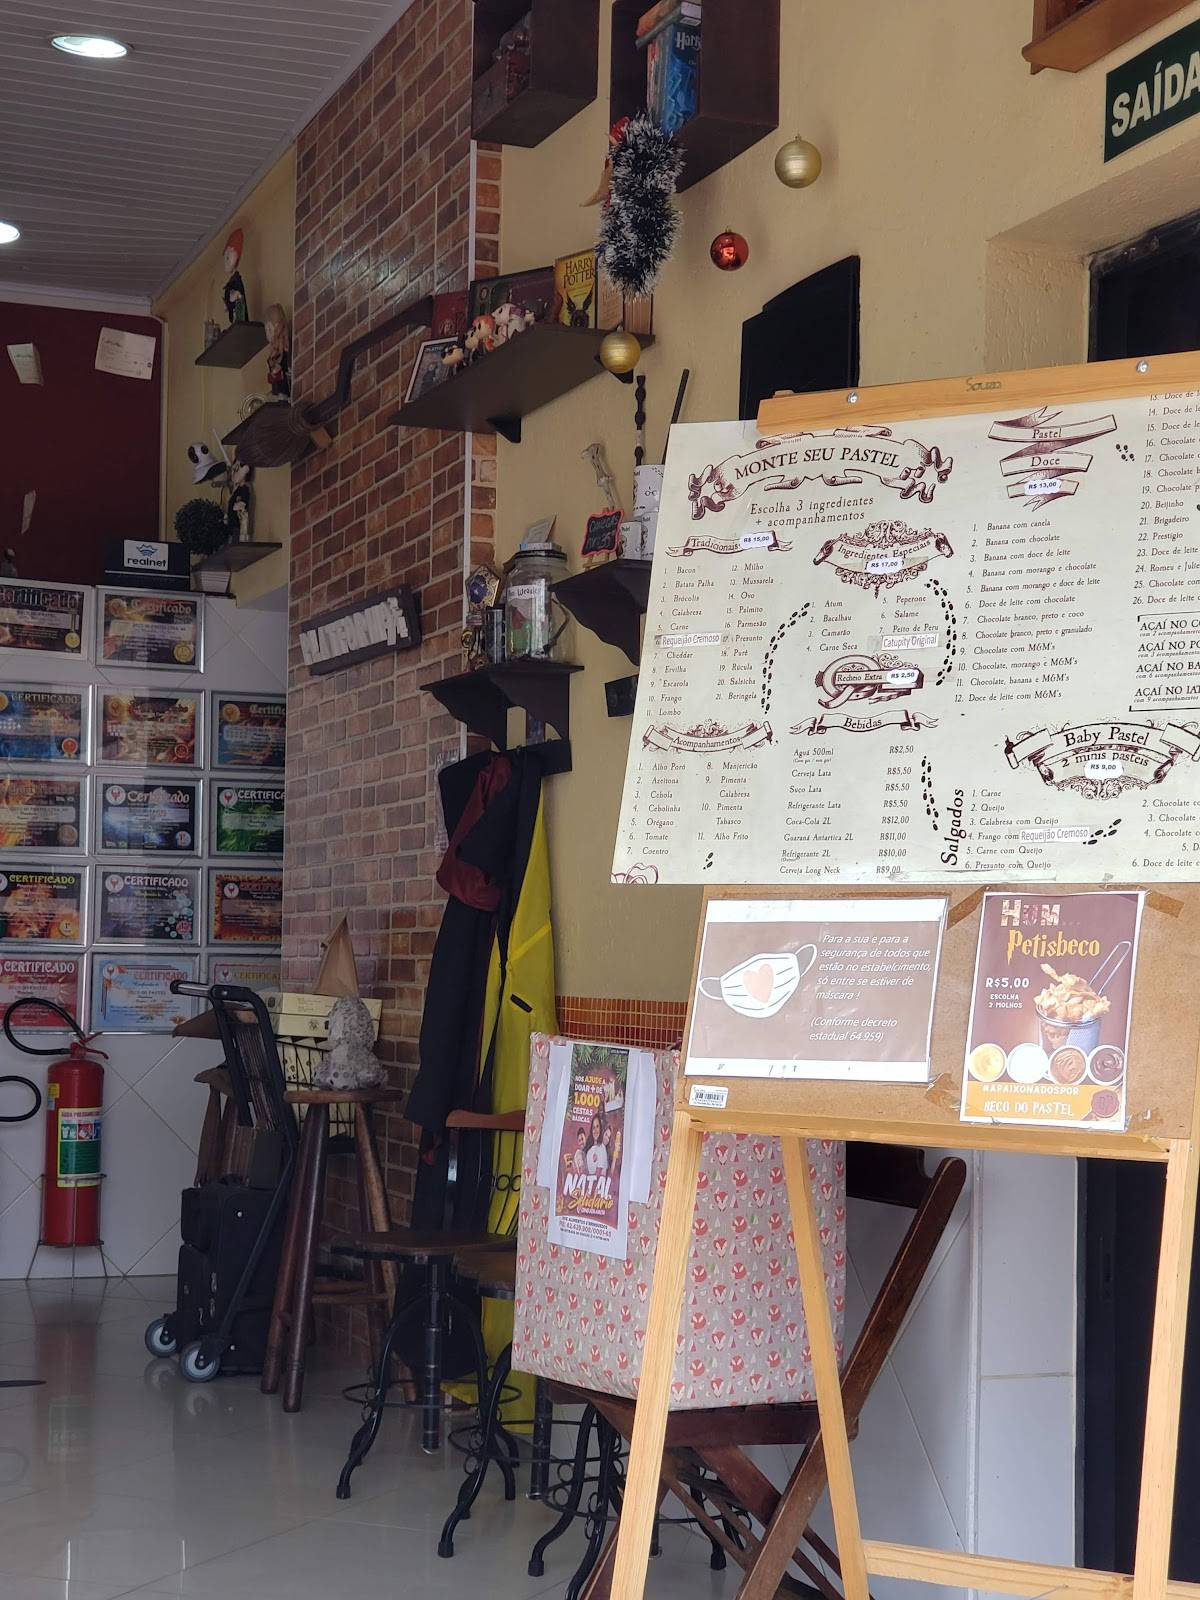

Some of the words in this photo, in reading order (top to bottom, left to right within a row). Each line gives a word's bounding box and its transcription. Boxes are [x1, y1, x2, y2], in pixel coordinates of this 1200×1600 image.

[676, 32, 700, 51] Harry
[1112, 51, 1200, 137] SAÍDA
[566, 257, 594, 275] HARRY
[564, 269, 595, 288] POTTER
[1032, 428, 1061, 439] Pastel
[735, 451, 798, 480] MONTE
[803, 448, 835, 462] SEU
[840, 448, 900, 468] PASTEL
[1031, 456, 1060, 467] Doce
[750, 503, 790, 515] Escolha
[797, 501, 803, 511] 3
[809, 497, 873, 513] ingredientes
[1156, 500, 1184, 509] Beijinho
[767, 512, 864, 528] acompanhamentos
[1154, 516, 1189, 526] Brigadeiro
[987, 523, 1010, 531] Banana
[1029, 535, 1060, 543] chocolate
[839, 545, 888, 560] Ingredientes
[893, 540, 931, 559] Especiais
[128, 558, 166, 567] realnet
[1044, 596, 1075, 604] chocolate
[978, 615, 1010, 623] Chocolate
[1042, 613, 1058, 621] preto
[1140, 619, 1167, 632] AÇAÍ
[1170, 621, 1187, 629] NO
[663, 637, 691, 647] Requeijão
[693, 635, 719, 643] Cremoso
[11, 693, 78, 704] CERTIFICADO
[844, 718, 882, 729] Bebidas
[1064, 730, 1100, 746] Baby
[1108, 726, 1149, 745] Pastel
[674, 736, 741, 748] Acompanhamentos
[813, 748, 833, 756] 500ml
[890, 745, 913, 753] R$2,50
[1062, 759, 1070, 767] 2
[1076, 752, 1106, 764] minis
[1113, 751, 1149, 766] pasteis
[792, 770, 815, 778] Cerveja
[887, 767, 911, 775] R$5,50
[981, 804, 1004, 812] Queijo
[882, 816, 909, 824] R$12,00
[1035, 817, 1058, 825] Queijo
[941, 789, 966, 865] Salgados
[978, 832, 1001, 842] Frango
[1022, 830, 1055, 841] Requeijão
[1057, 829, 1088, 838] Cremoso
[9, 875, 75, 884] CERTIFICADO
[124, 876, 188, 887] CERTIFICADO
[823, 935, 844, 943] Para
[879, 936, 900, 945] para
[1007, 930, 1100, 965] Petisbeco
[821, 950, 867, 960] segurança
[870, 949, 882, 957] de
[884, 949, 910, 957] todos
[913, 951, 929, 959] que
[4, 961, 74, 973] CERTIFICADO
[819, 963, 843, 971] estão
[817, 976, 828, 985] só
[831, 977, 853, 985] entre
[870, 977, 899, 986] estiver
[903, 977, 914, 985] de
[816, 990, 854, 999] máscara
[811, 1017, 859, 1027] (Conforme
[862, 1017, 897, 1027] decreto
[810, 1031, 848, 1041] estadual
[850, 1032, 883, 1042] 64.959)
[574, 1092, 600, 1107] 1.000
[573, 1107, 592, 1116] CESTAS
[984, 1101, 1009, 1112] BECO
[1015, 1102, 1028, 1112] DO
[1032, 1102, 1074, 1116] PASTEL
[563, 1173, 611, 1200] NATAL
